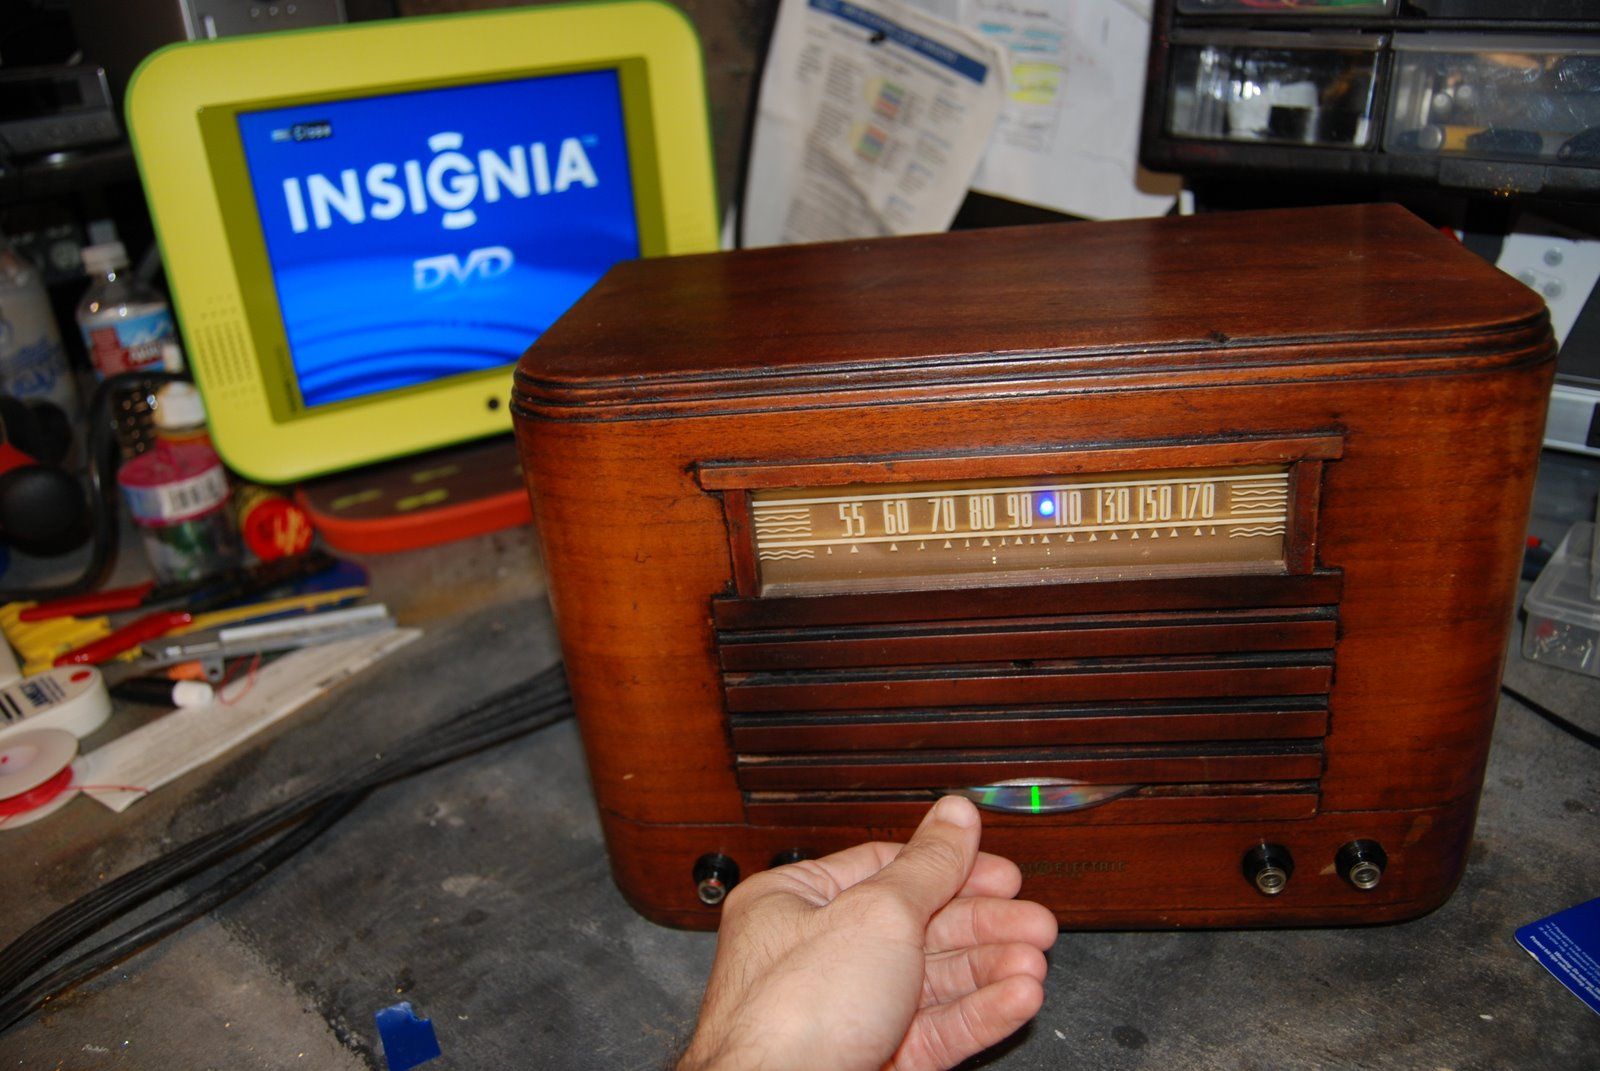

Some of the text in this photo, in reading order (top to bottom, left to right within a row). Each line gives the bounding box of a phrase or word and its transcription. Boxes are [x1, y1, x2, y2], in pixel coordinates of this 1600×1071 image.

[282, 132, 598, 233] INSIGNIA
[412, 246, 513, 292] DVD
[838, 483, 1215, 537] 55 60 70 80 90 110 130 150 170
